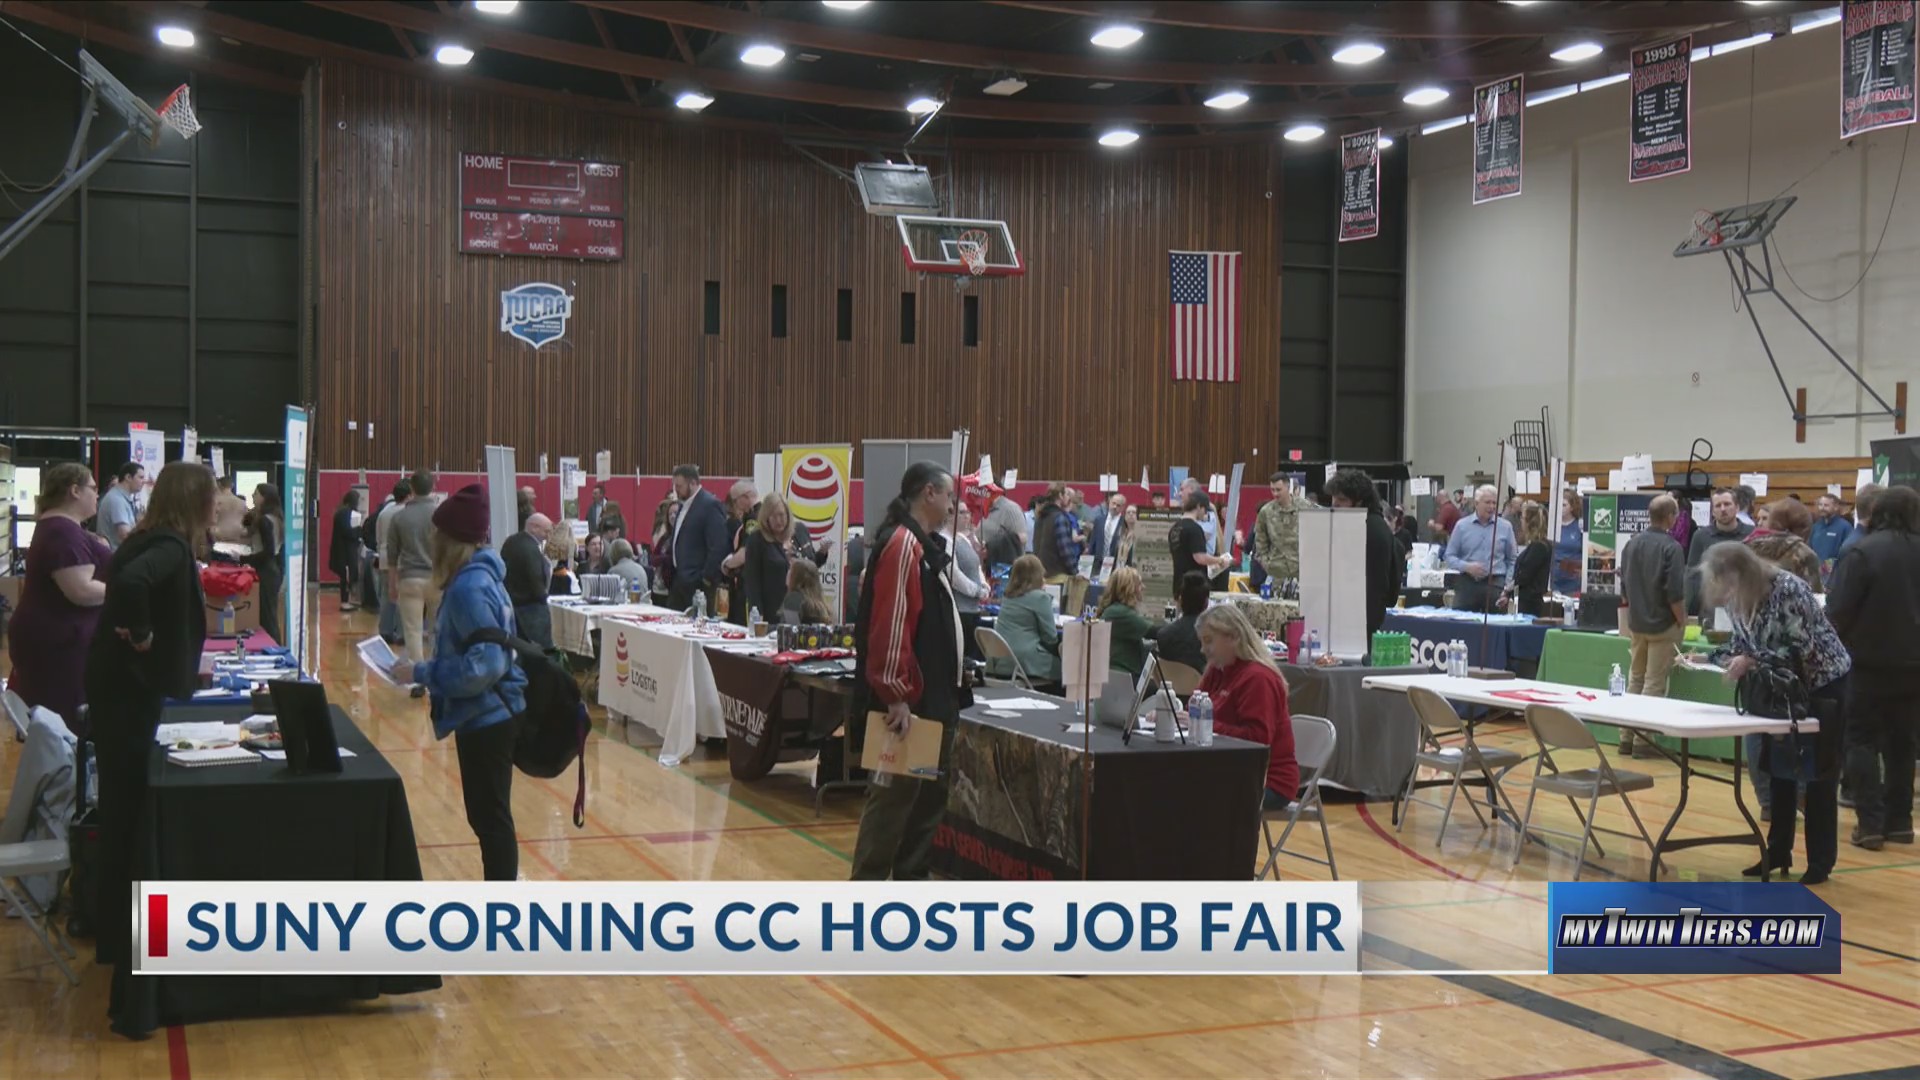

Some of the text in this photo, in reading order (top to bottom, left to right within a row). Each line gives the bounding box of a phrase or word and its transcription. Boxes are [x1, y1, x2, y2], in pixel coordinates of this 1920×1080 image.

[1645, 44, 1677, 64] 1995
[465, 155, 504, 170] HOME
[584, 163, 621, 178] GUEST
[475, 197, 497, 205] BONUS
[470, 212, 498, 221] FOULS
[527, 215, 560, 225] PLAYER
[588, 219, 616, 228] FOULS
[469, 239, 499, 249] SCORE
[529, 242, 559, 251] MATCH
[588, 245, 617, 255] SCORE
[1620, 523, 1639, 531] SINCE
